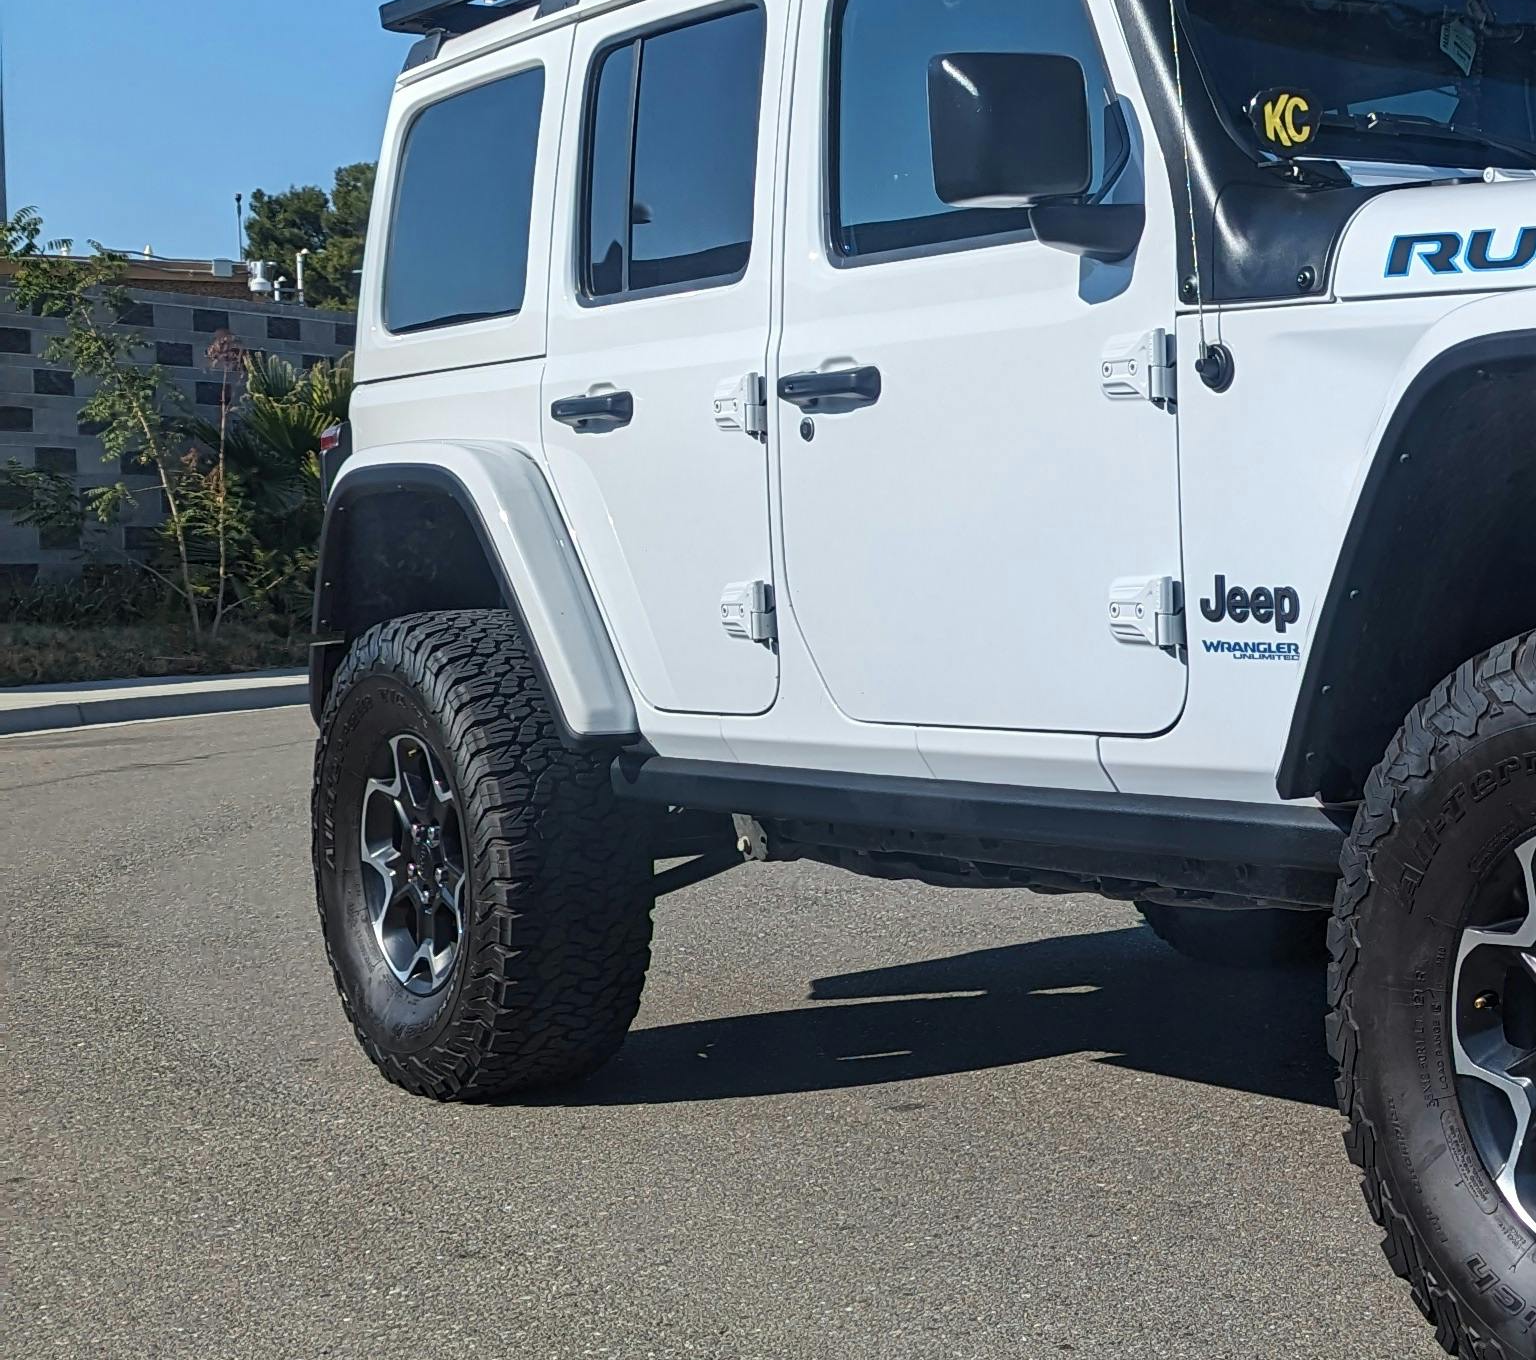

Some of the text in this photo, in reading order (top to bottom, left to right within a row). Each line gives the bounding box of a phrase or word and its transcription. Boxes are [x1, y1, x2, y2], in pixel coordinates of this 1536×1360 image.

[1263, 93, 1310, 146] KC
[1200, 574, 1300, 633] Jeep
[1202, 639, 1300, 654] WRANGLER
